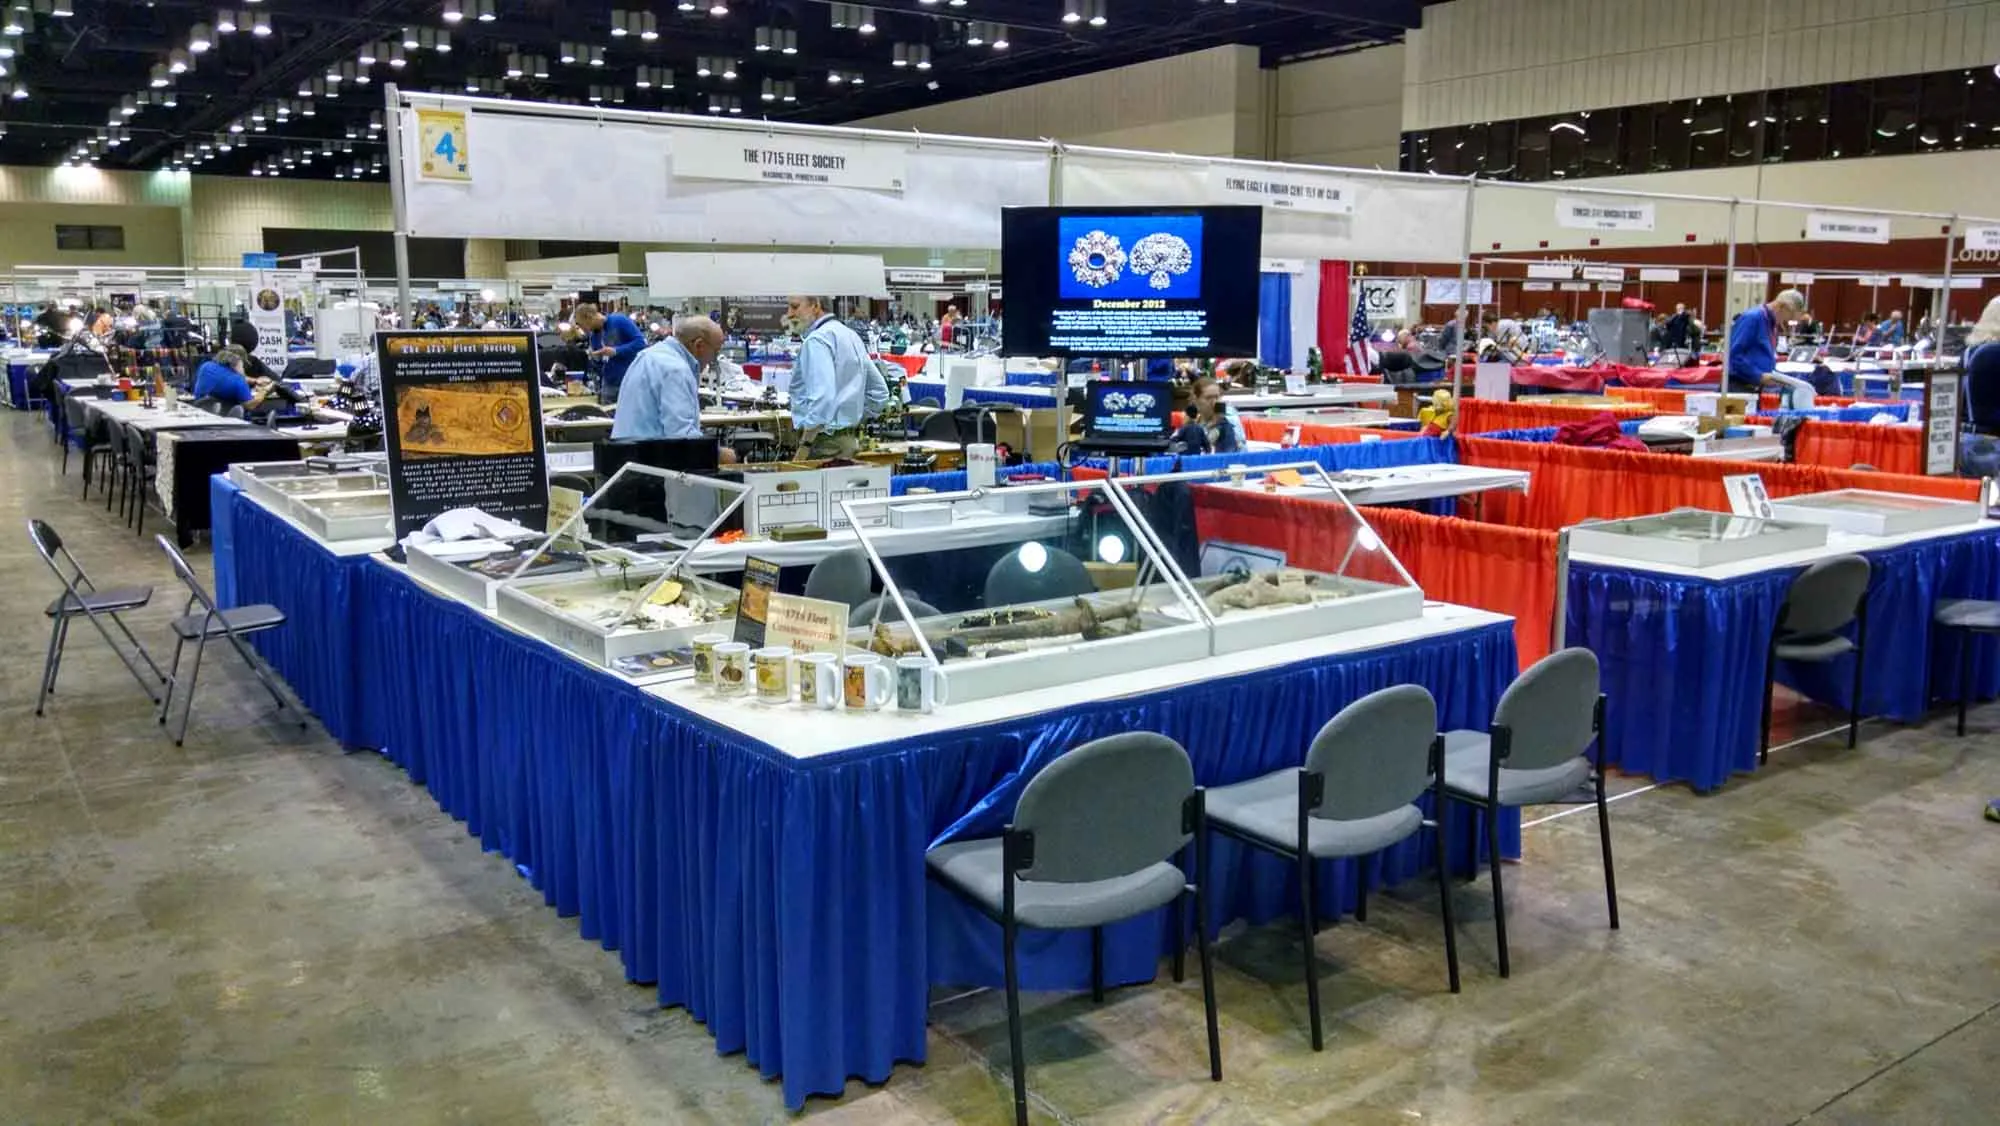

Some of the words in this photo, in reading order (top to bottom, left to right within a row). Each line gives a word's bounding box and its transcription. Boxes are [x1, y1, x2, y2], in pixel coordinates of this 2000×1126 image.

[434, 131, 458, 165] 4
[744, 149, 759, 163] THE
[762, 151, 785, 165] 1715
[786, 152, 809, 167] FLEET
[812, 154, 845, 169] SOCIETY
[1093, 299, 1141, 309] December
[1142, 299, 1165, 309] 2012
[260, 336, 282, 345] CASH
[786, 608, 805, 620] 1715
[807, 612, 828, 625] Fleet
